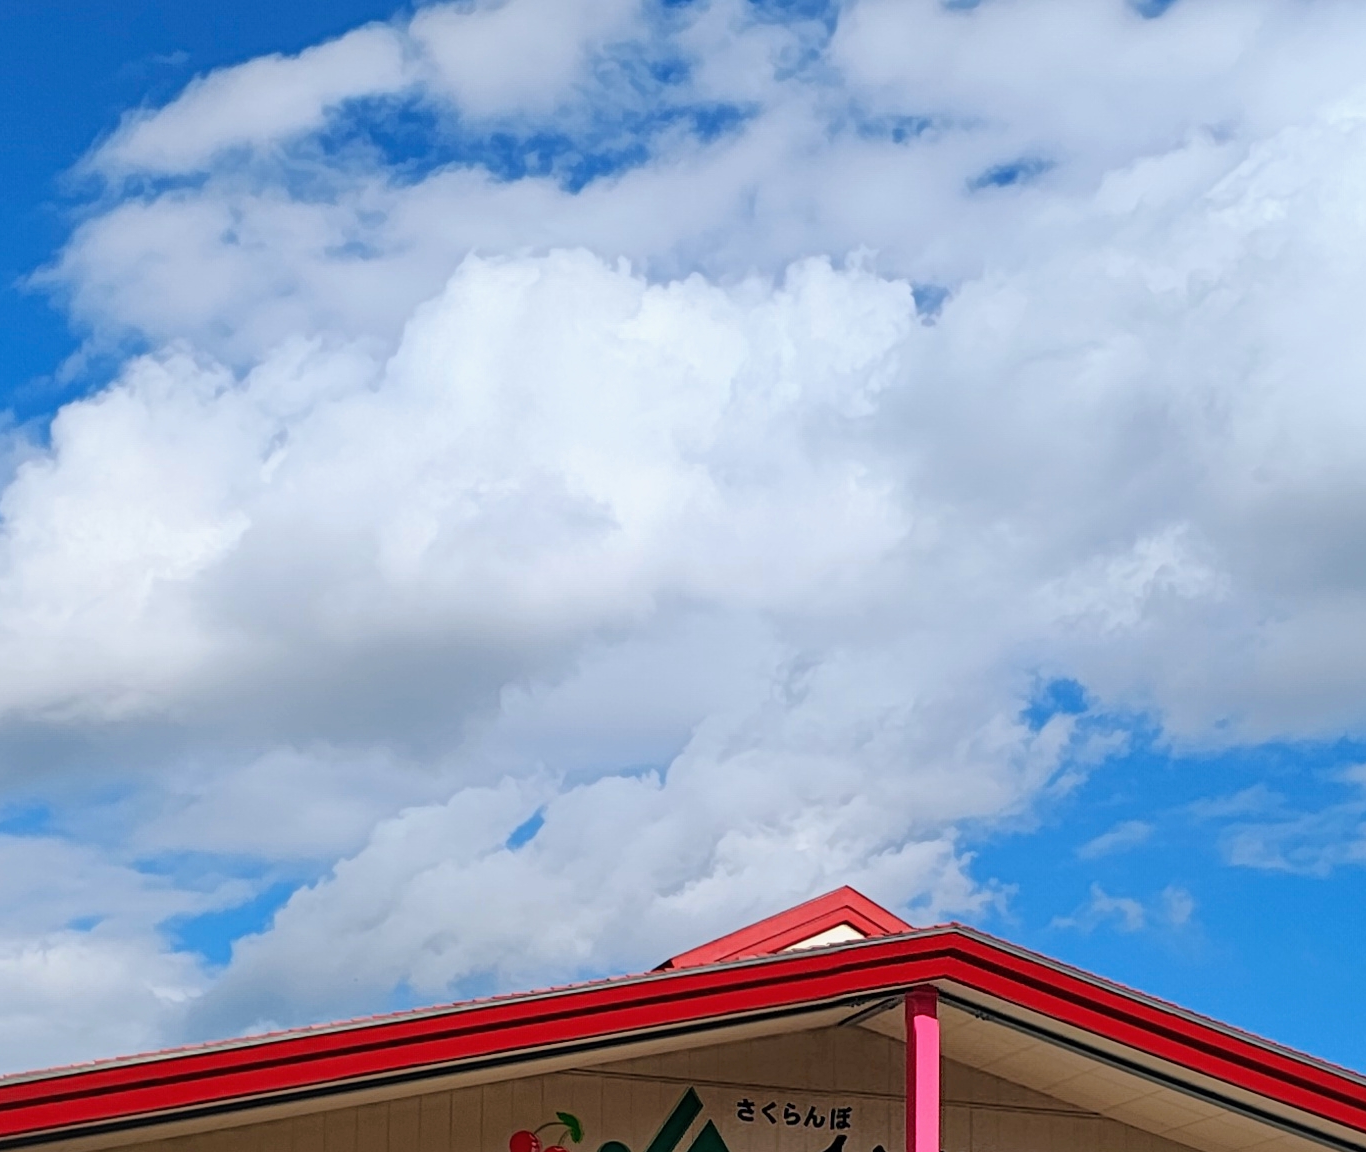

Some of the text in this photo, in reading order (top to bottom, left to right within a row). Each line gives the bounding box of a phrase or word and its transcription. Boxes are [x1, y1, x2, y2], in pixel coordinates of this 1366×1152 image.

[736, 1098, 853, 1130] さくらんぼ
